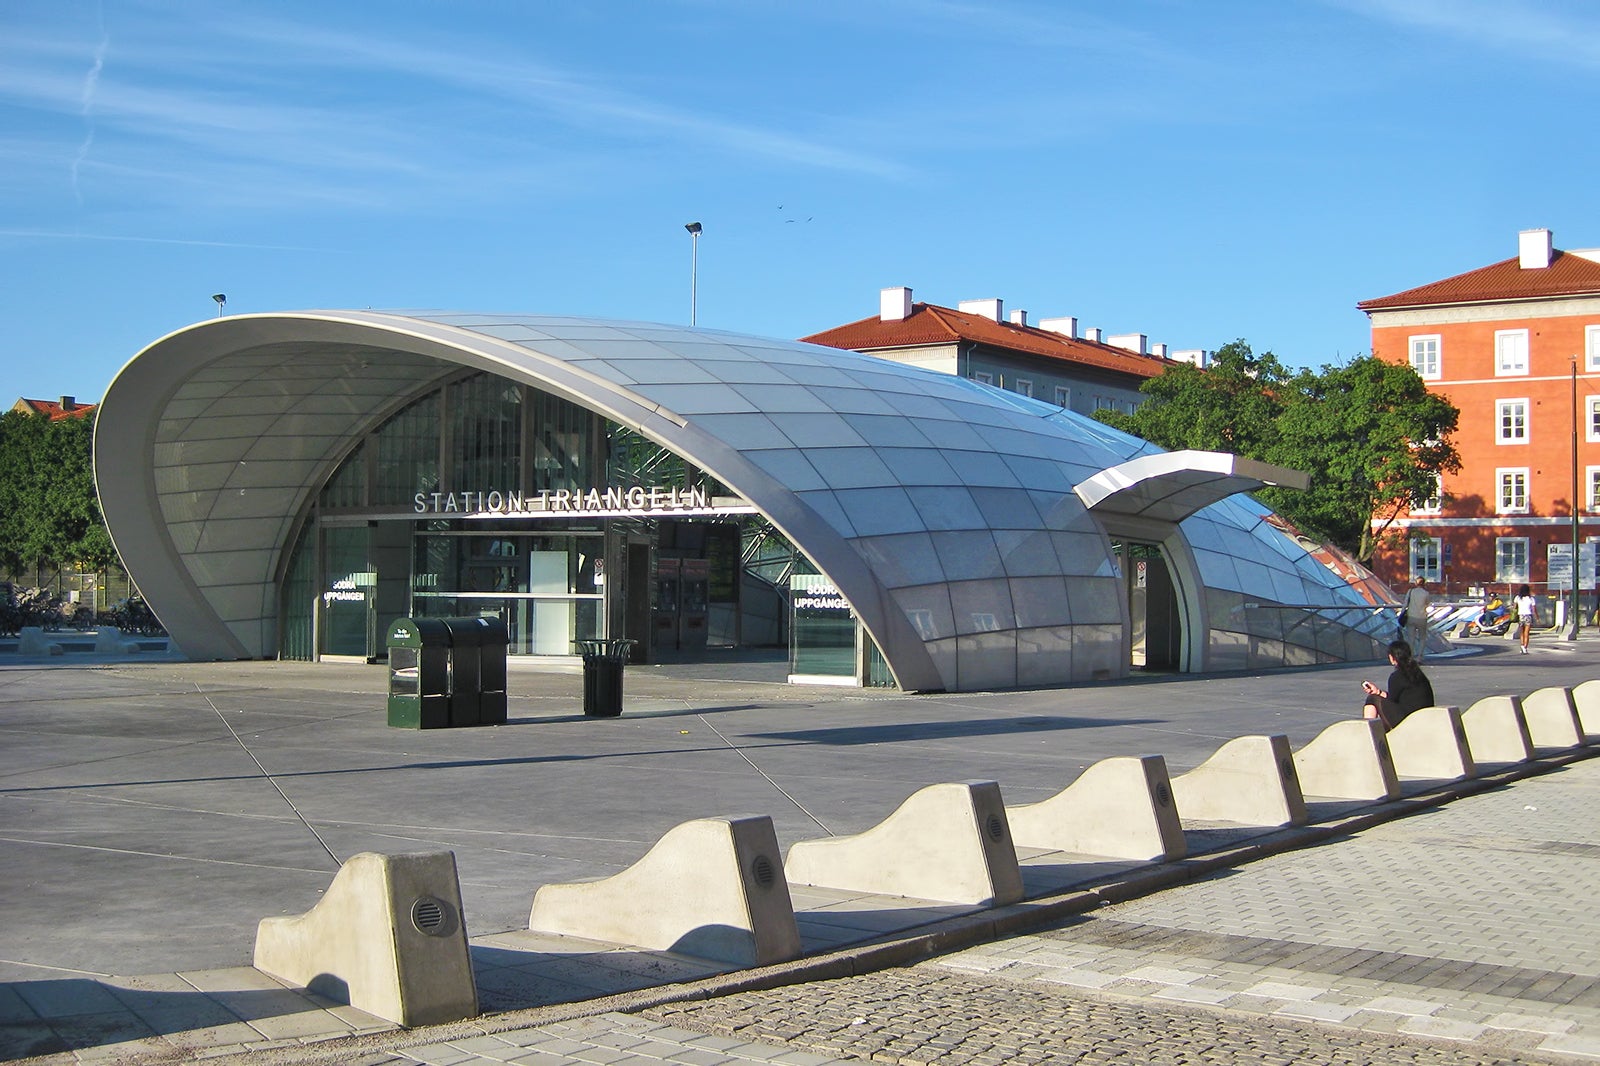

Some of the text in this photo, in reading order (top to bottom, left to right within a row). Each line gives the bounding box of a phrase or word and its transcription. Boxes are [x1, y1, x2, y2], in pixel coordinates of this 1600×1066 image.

[414, 485, 707, 513] STATION TRIANGELN
[807, 583, 838, 595] SÖDR
[324, 591, 365, 601] UPPGÅNGEN
[794, 597, 850, 609] UPPGÅNGE
